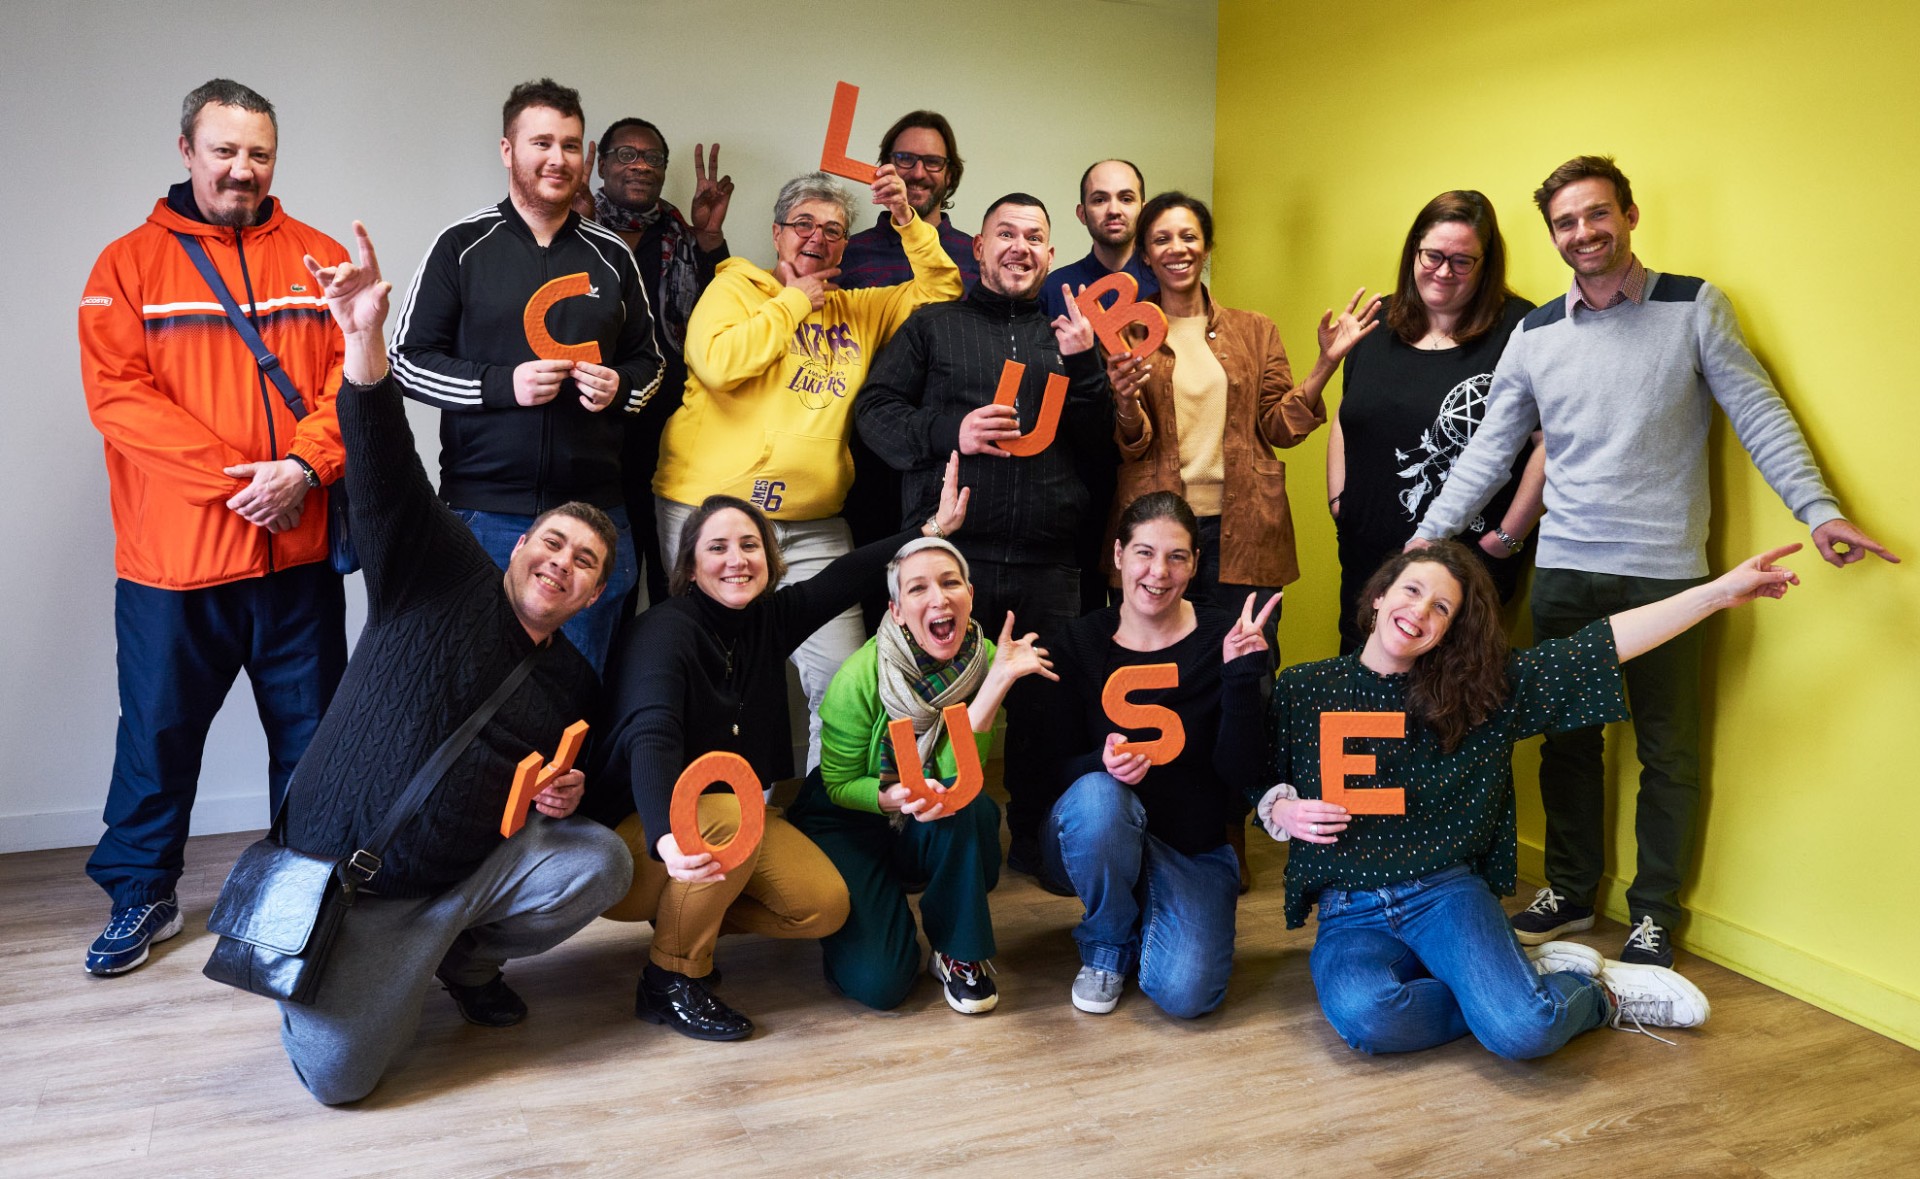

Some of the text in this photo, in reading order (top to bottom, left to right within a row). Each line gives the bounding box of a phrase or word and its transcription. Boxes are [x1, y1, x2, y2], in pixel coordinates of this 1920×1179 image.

[820, 80, 880, 185] L
[523, 271, 602, 365] C
[1074, 271, 1169, 368] B
[786, 366, 847, 398] LAKERS
[992, 358, 1070, 457] U
[750, 479, 769, 509] AMES
[763, 480, 786, 512] 6
[888, 702, 984, 816] U
[1101, 662, 1186, 766] S
[1319, 711, 1406, 815] E
